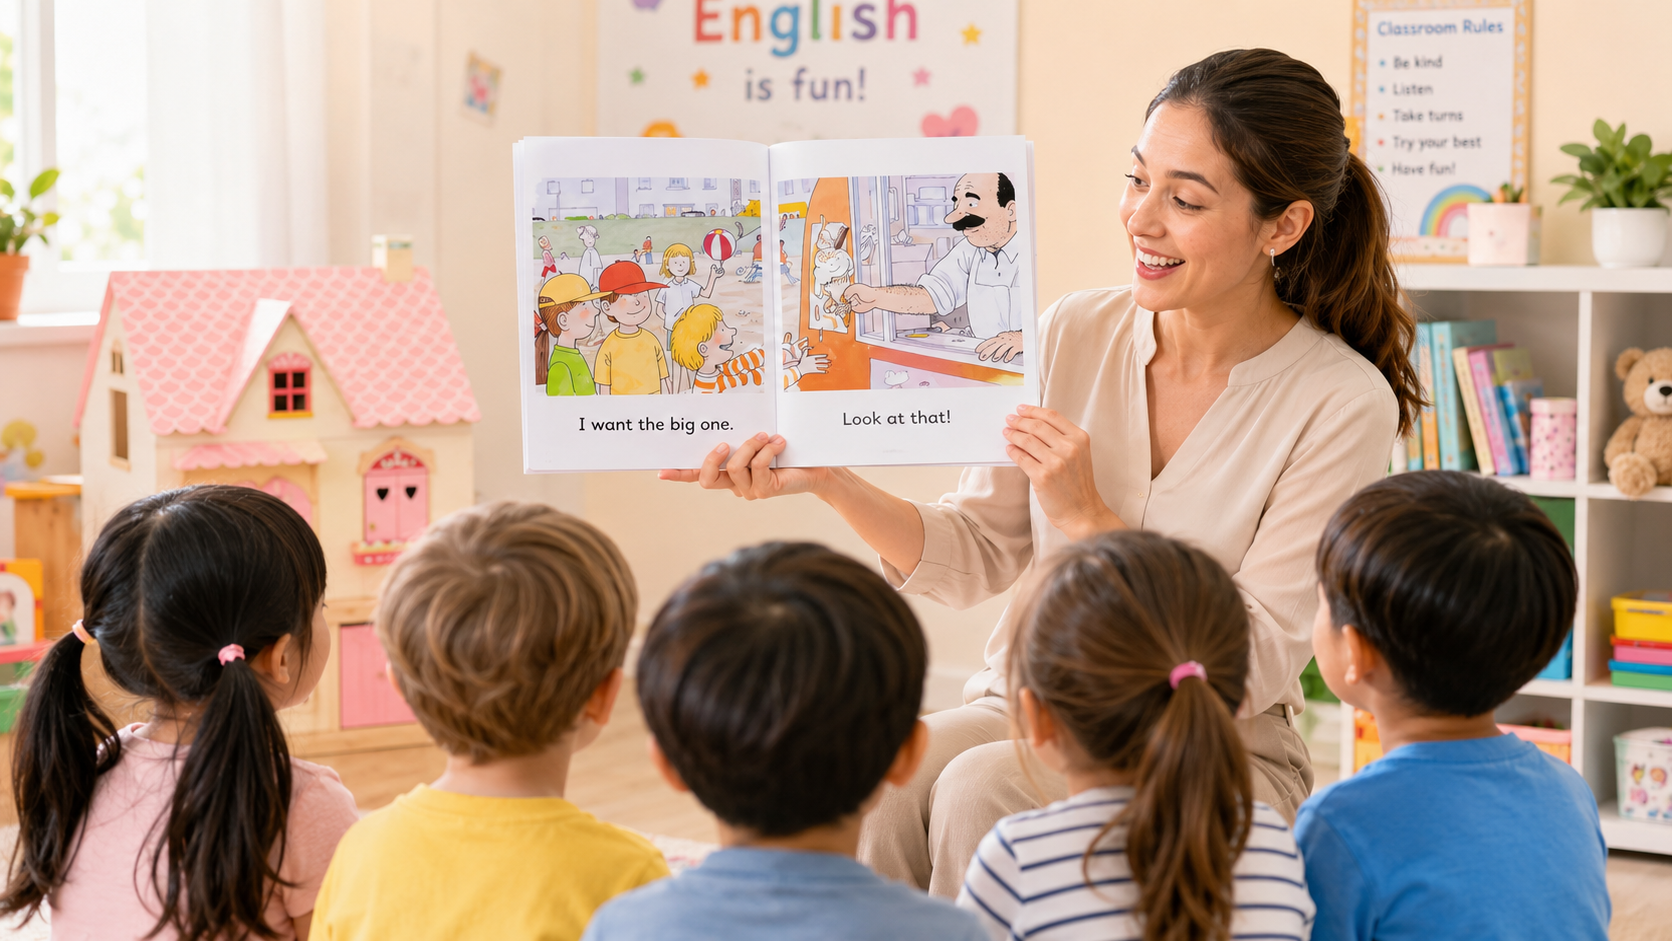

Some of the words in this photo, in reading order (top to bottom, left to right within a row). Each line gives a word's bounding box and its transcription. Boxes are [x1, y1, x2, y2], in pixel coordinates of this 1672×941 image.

[694, 0, 918, 58] English
[1377, 21, 1458, 37] Classroom
[1462, 18, 1504, 34] Rules
[1393, 56, 1410, 70] Be
[1414, 55, 1443, 69] kind
[745, 68, 774, 101] is
[792, 67, 867, 101] fun!
[1393, 83, 1434, 96] Listen
[1393, 108, 1424, 122] Take
[1428, 110, 1464, 122] turns
[1393, 135, 1414, 152] Try
[1418, 138, 1448, 151] your
[1452, 136, 1482, 149] best
[1391, 162, 1425, 176] Have
[1428, 162, 1457, 176] fun!
[578, 417, 586, 432] I
[591, 418, 634, 431] want
[637, 416, 665, 431] the
[670, 416, 695, 435] big
[700, 420, 734, 431] one.
[843, 411, 882, 426] Look
[886, 412, 905, 425] at
[910, 410, 951, 425] that!
